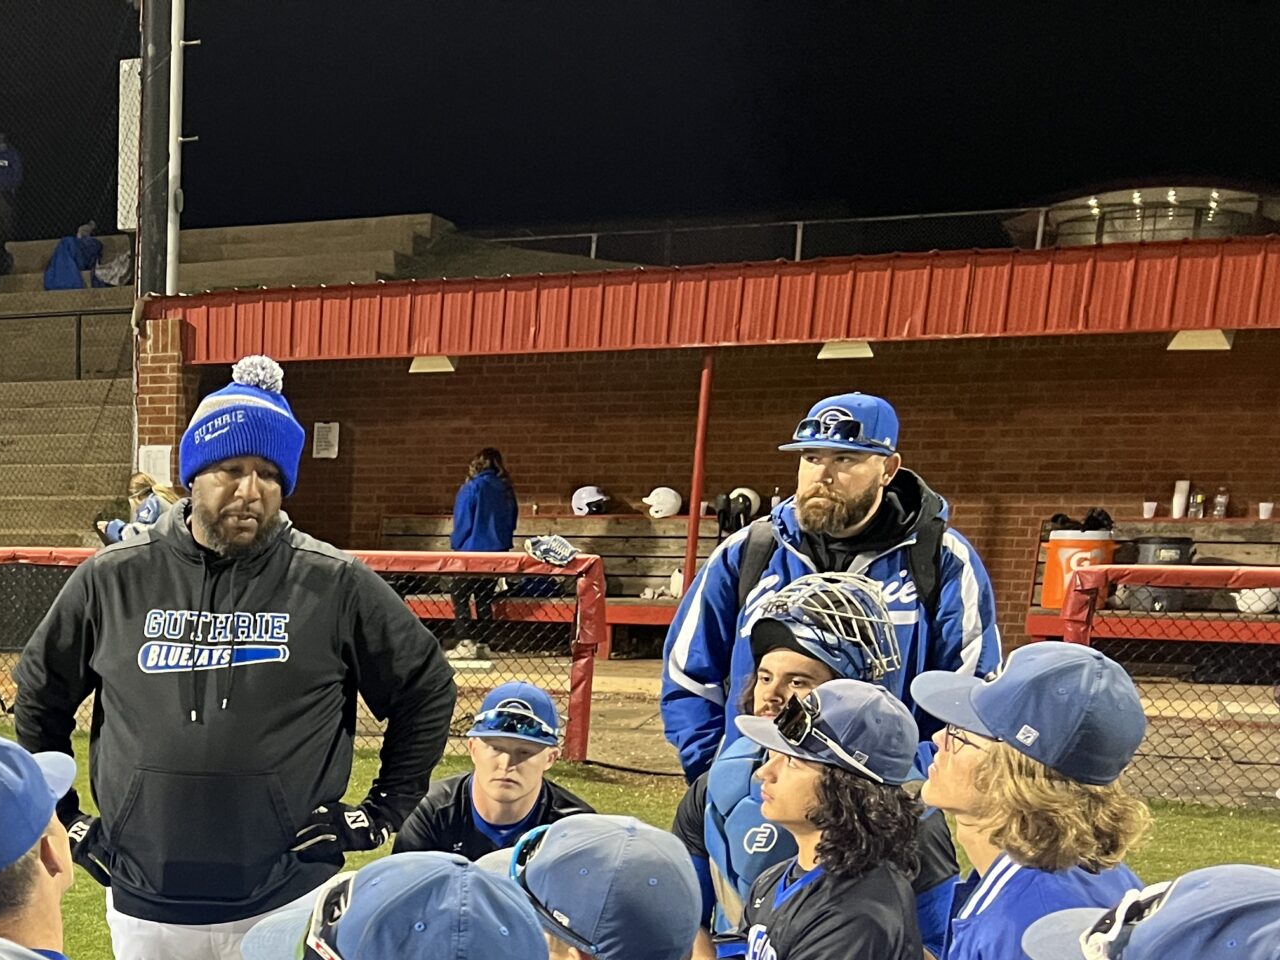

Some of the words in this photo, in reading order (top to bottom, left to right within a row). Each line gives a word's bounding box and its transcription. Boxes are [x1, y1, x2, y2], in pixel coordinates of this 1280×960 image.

[194, 411, 245, 444] GUTHRIE
[144, 609, 290, 642] GUTHRIE
[146, 645, 232, 667] BLUEJAYS
